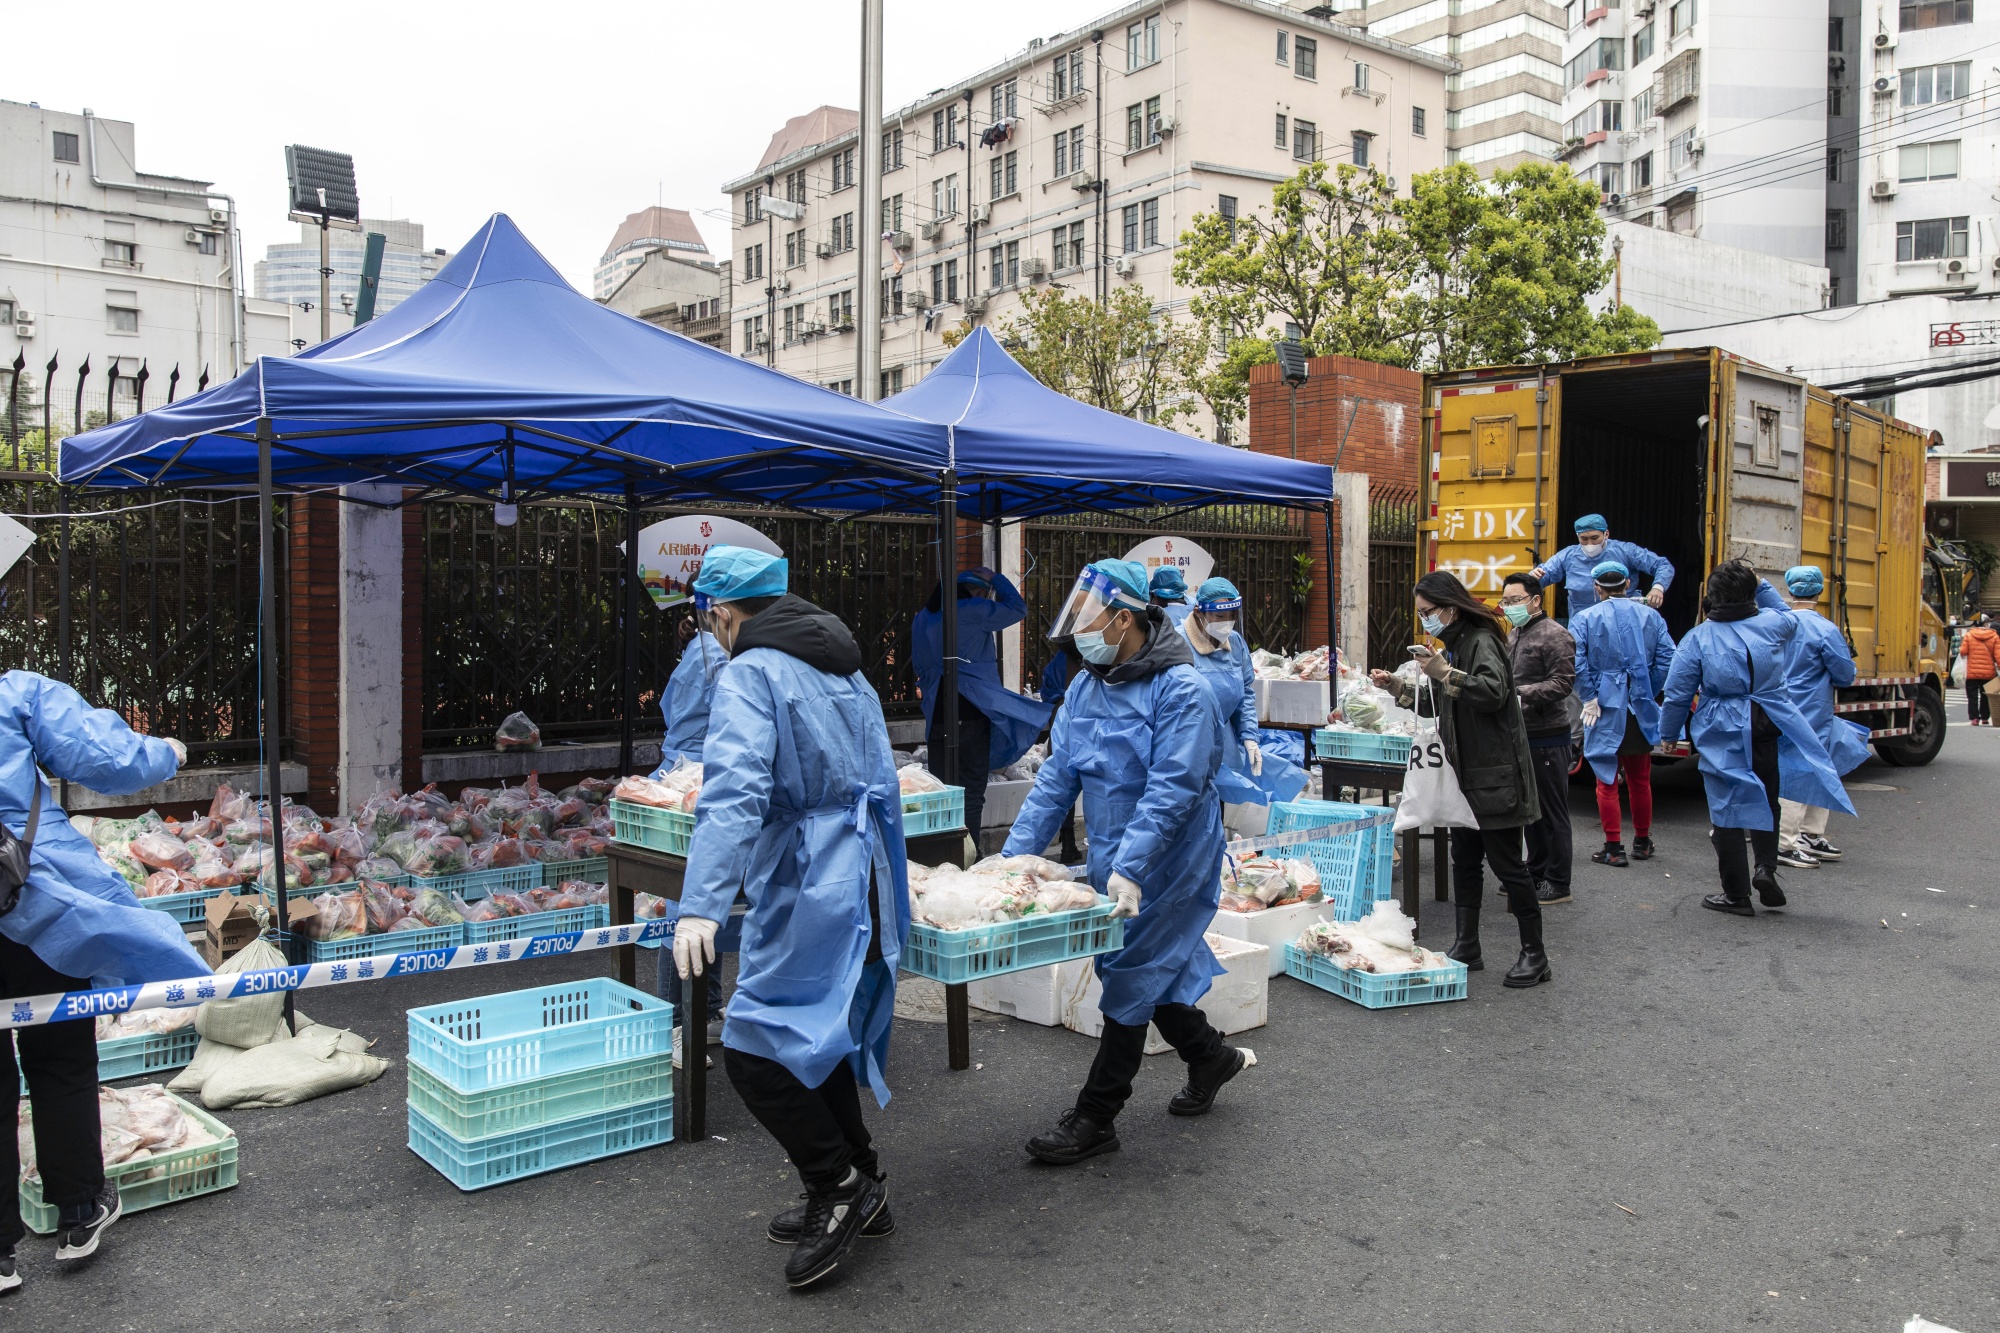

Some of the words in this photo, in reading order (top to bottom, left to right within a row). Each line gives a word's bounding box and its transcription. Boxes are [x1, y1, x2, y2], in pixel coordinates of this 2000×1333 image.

[658, 542, 714, 556] 人民城市人
[1409, 743, 1447, 771] RS
[533, 936, 573, 955] POLICE
[400, 952, 446, 973] POLICE
[245, 969, 299, 993] POLICE
[67, 990, 129, 1016] POLICE
